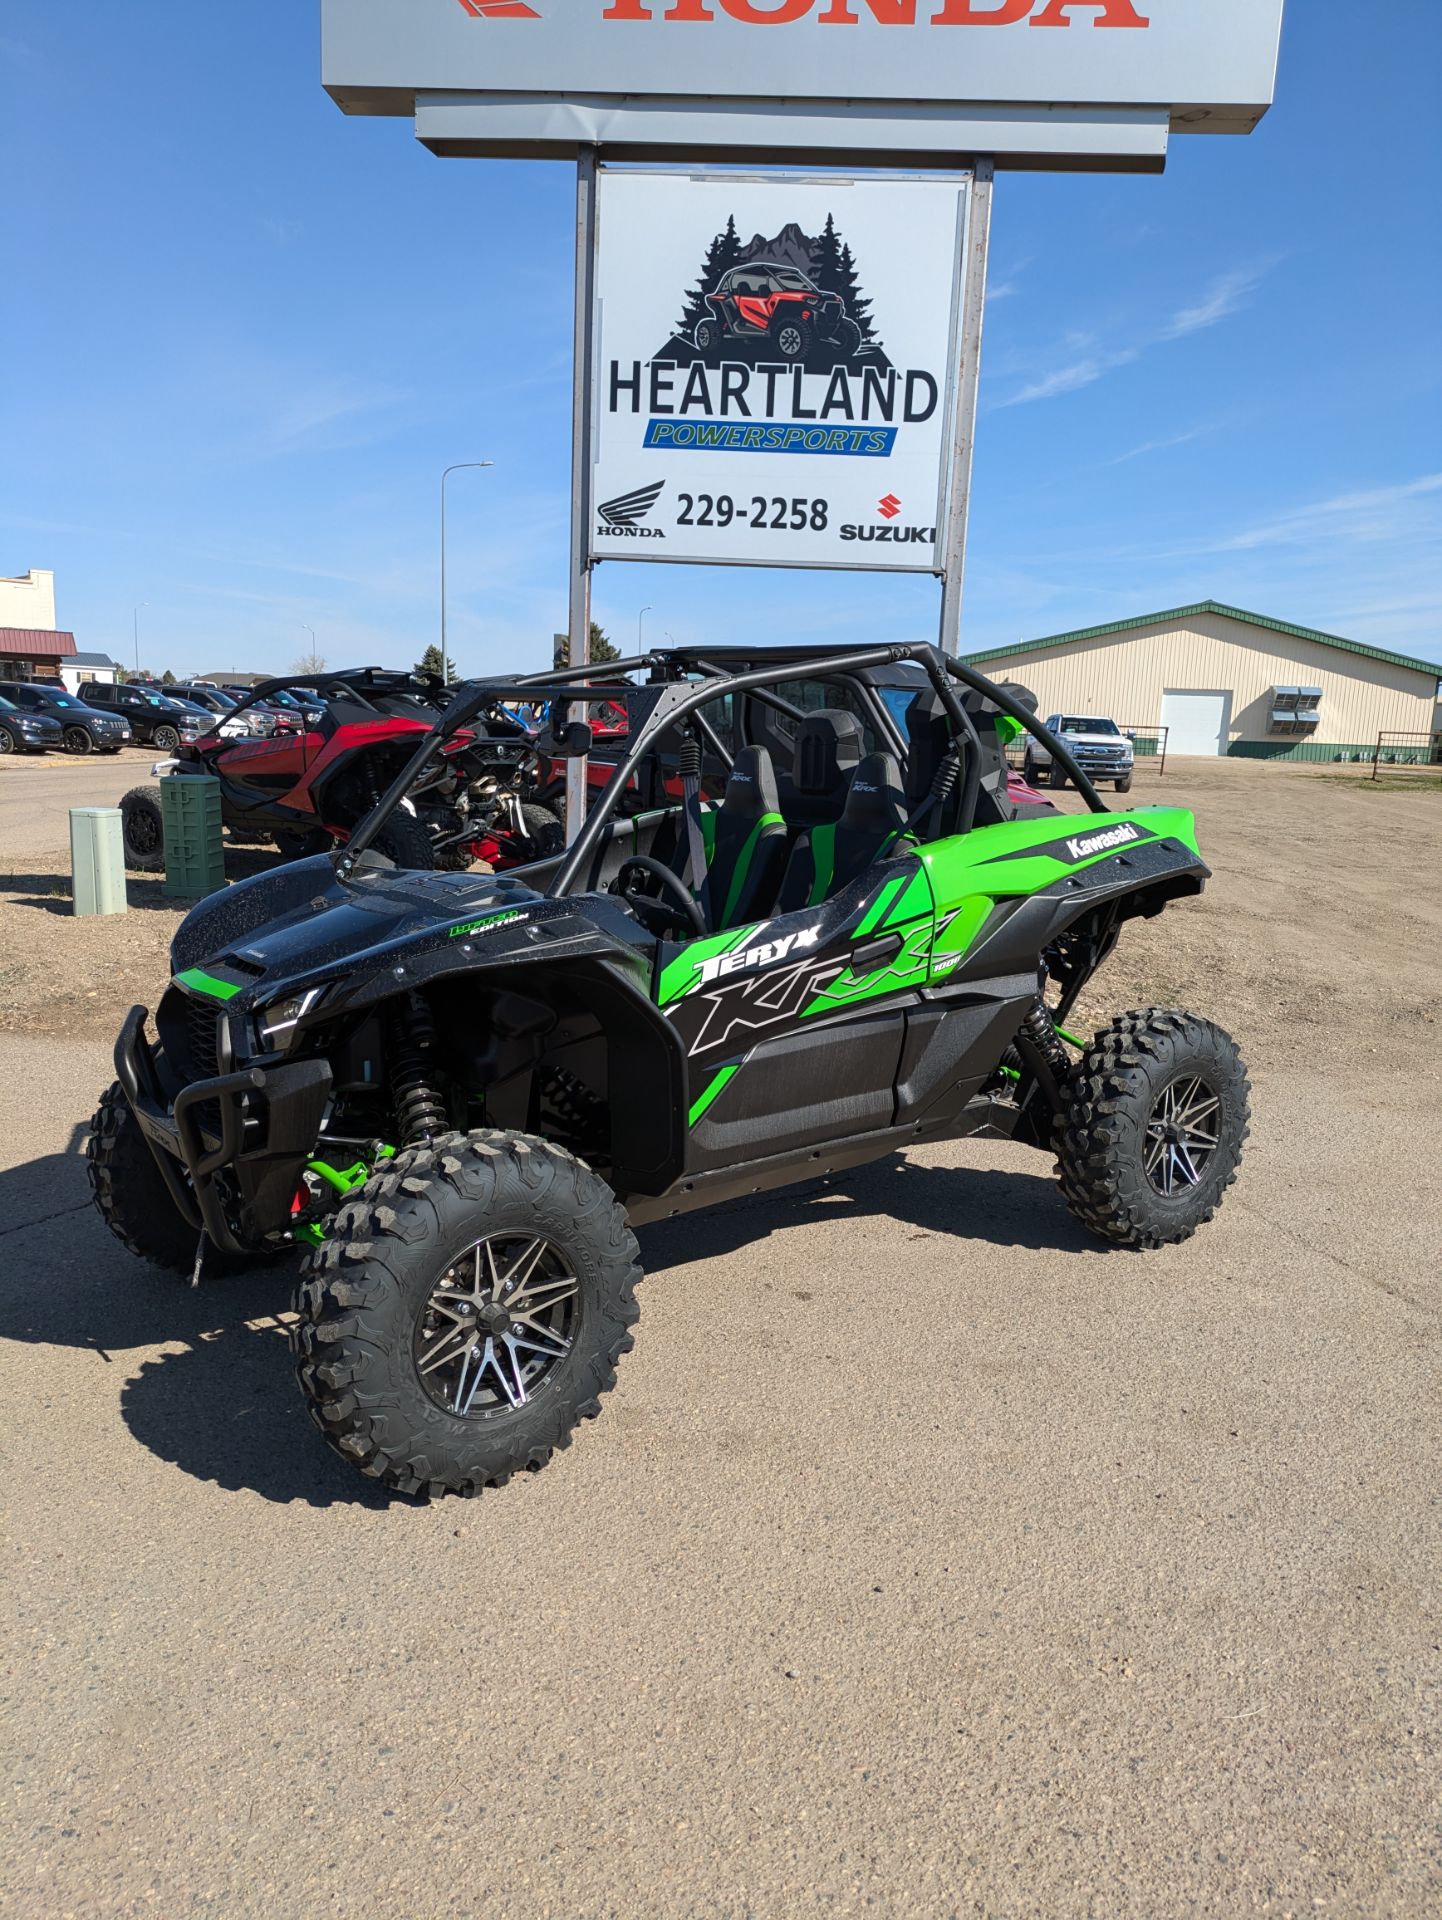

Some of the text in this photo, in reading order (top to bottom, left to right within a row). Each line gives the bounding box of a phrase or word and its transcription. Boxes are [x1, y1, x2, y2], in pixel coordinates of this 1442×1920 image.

[609, 359, 938, 423] HEARTLAND
[650, 423, 888, 452] POWERSPORTS
[676, 493, 828, 531] 229-2258
[596, 526, 666, 538] HONDA
[839, 524, 936, 544] SUZUKI
[1066, 823, 1139, 858] Kawasaki
[693, 924, 823, 984] TERYX
